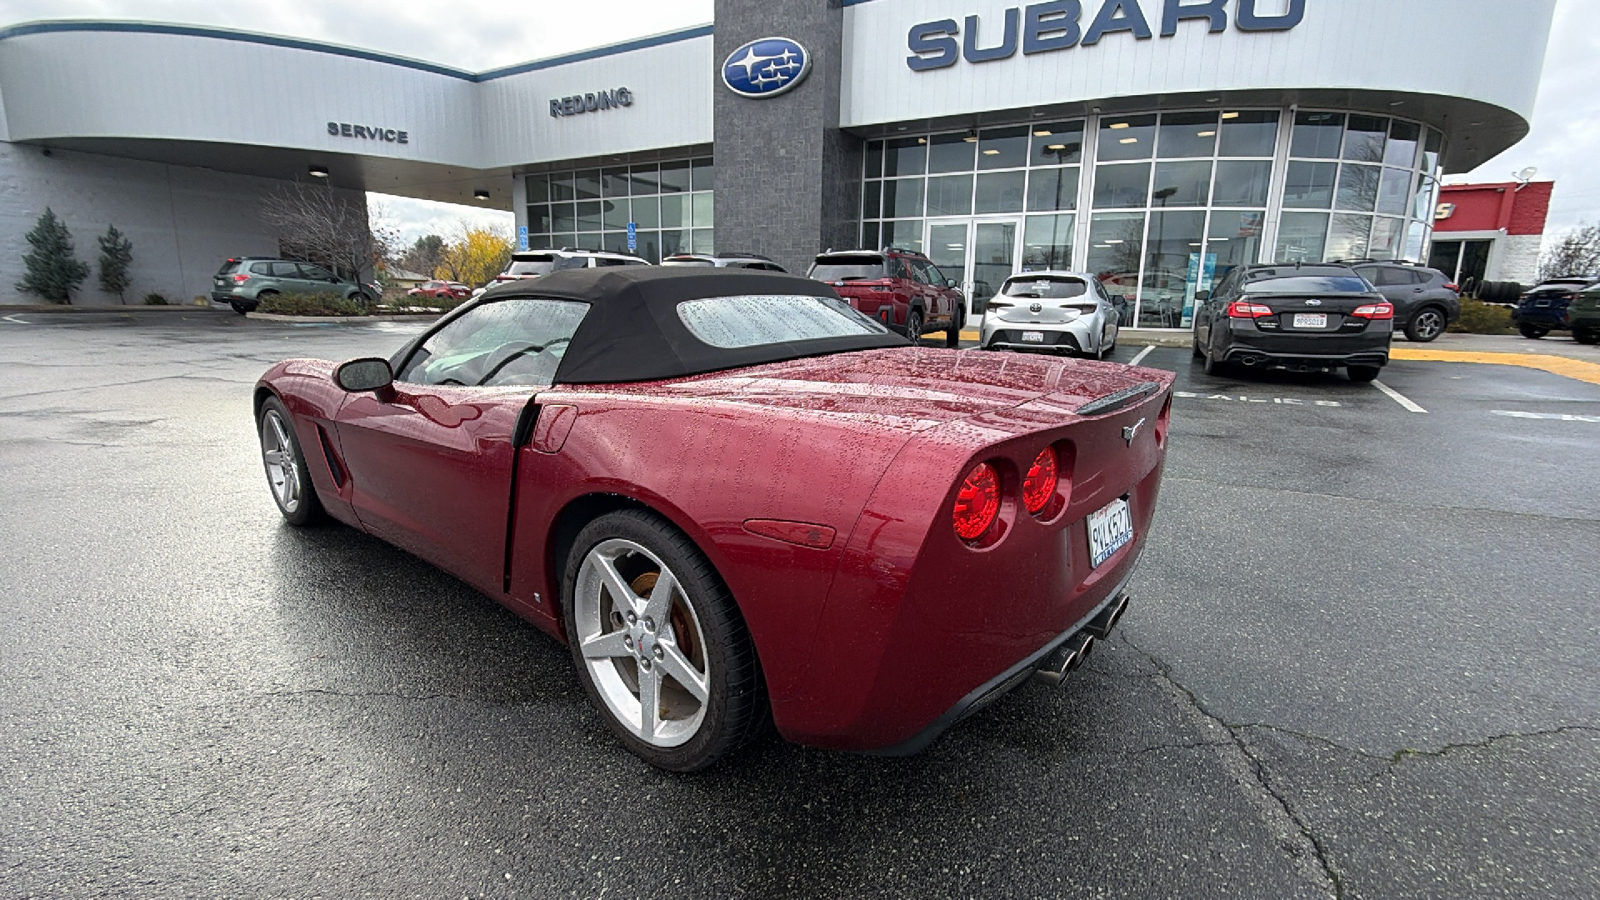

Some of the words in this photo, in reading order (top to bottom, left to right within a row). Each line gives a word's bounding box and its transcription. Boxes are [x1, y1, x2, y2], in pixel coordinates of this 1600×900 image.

[907, 0, 1305, 71] SUBARU
[549, 86, 632, 118] REDDING
[327, 122, 408, 144] SERVICE
